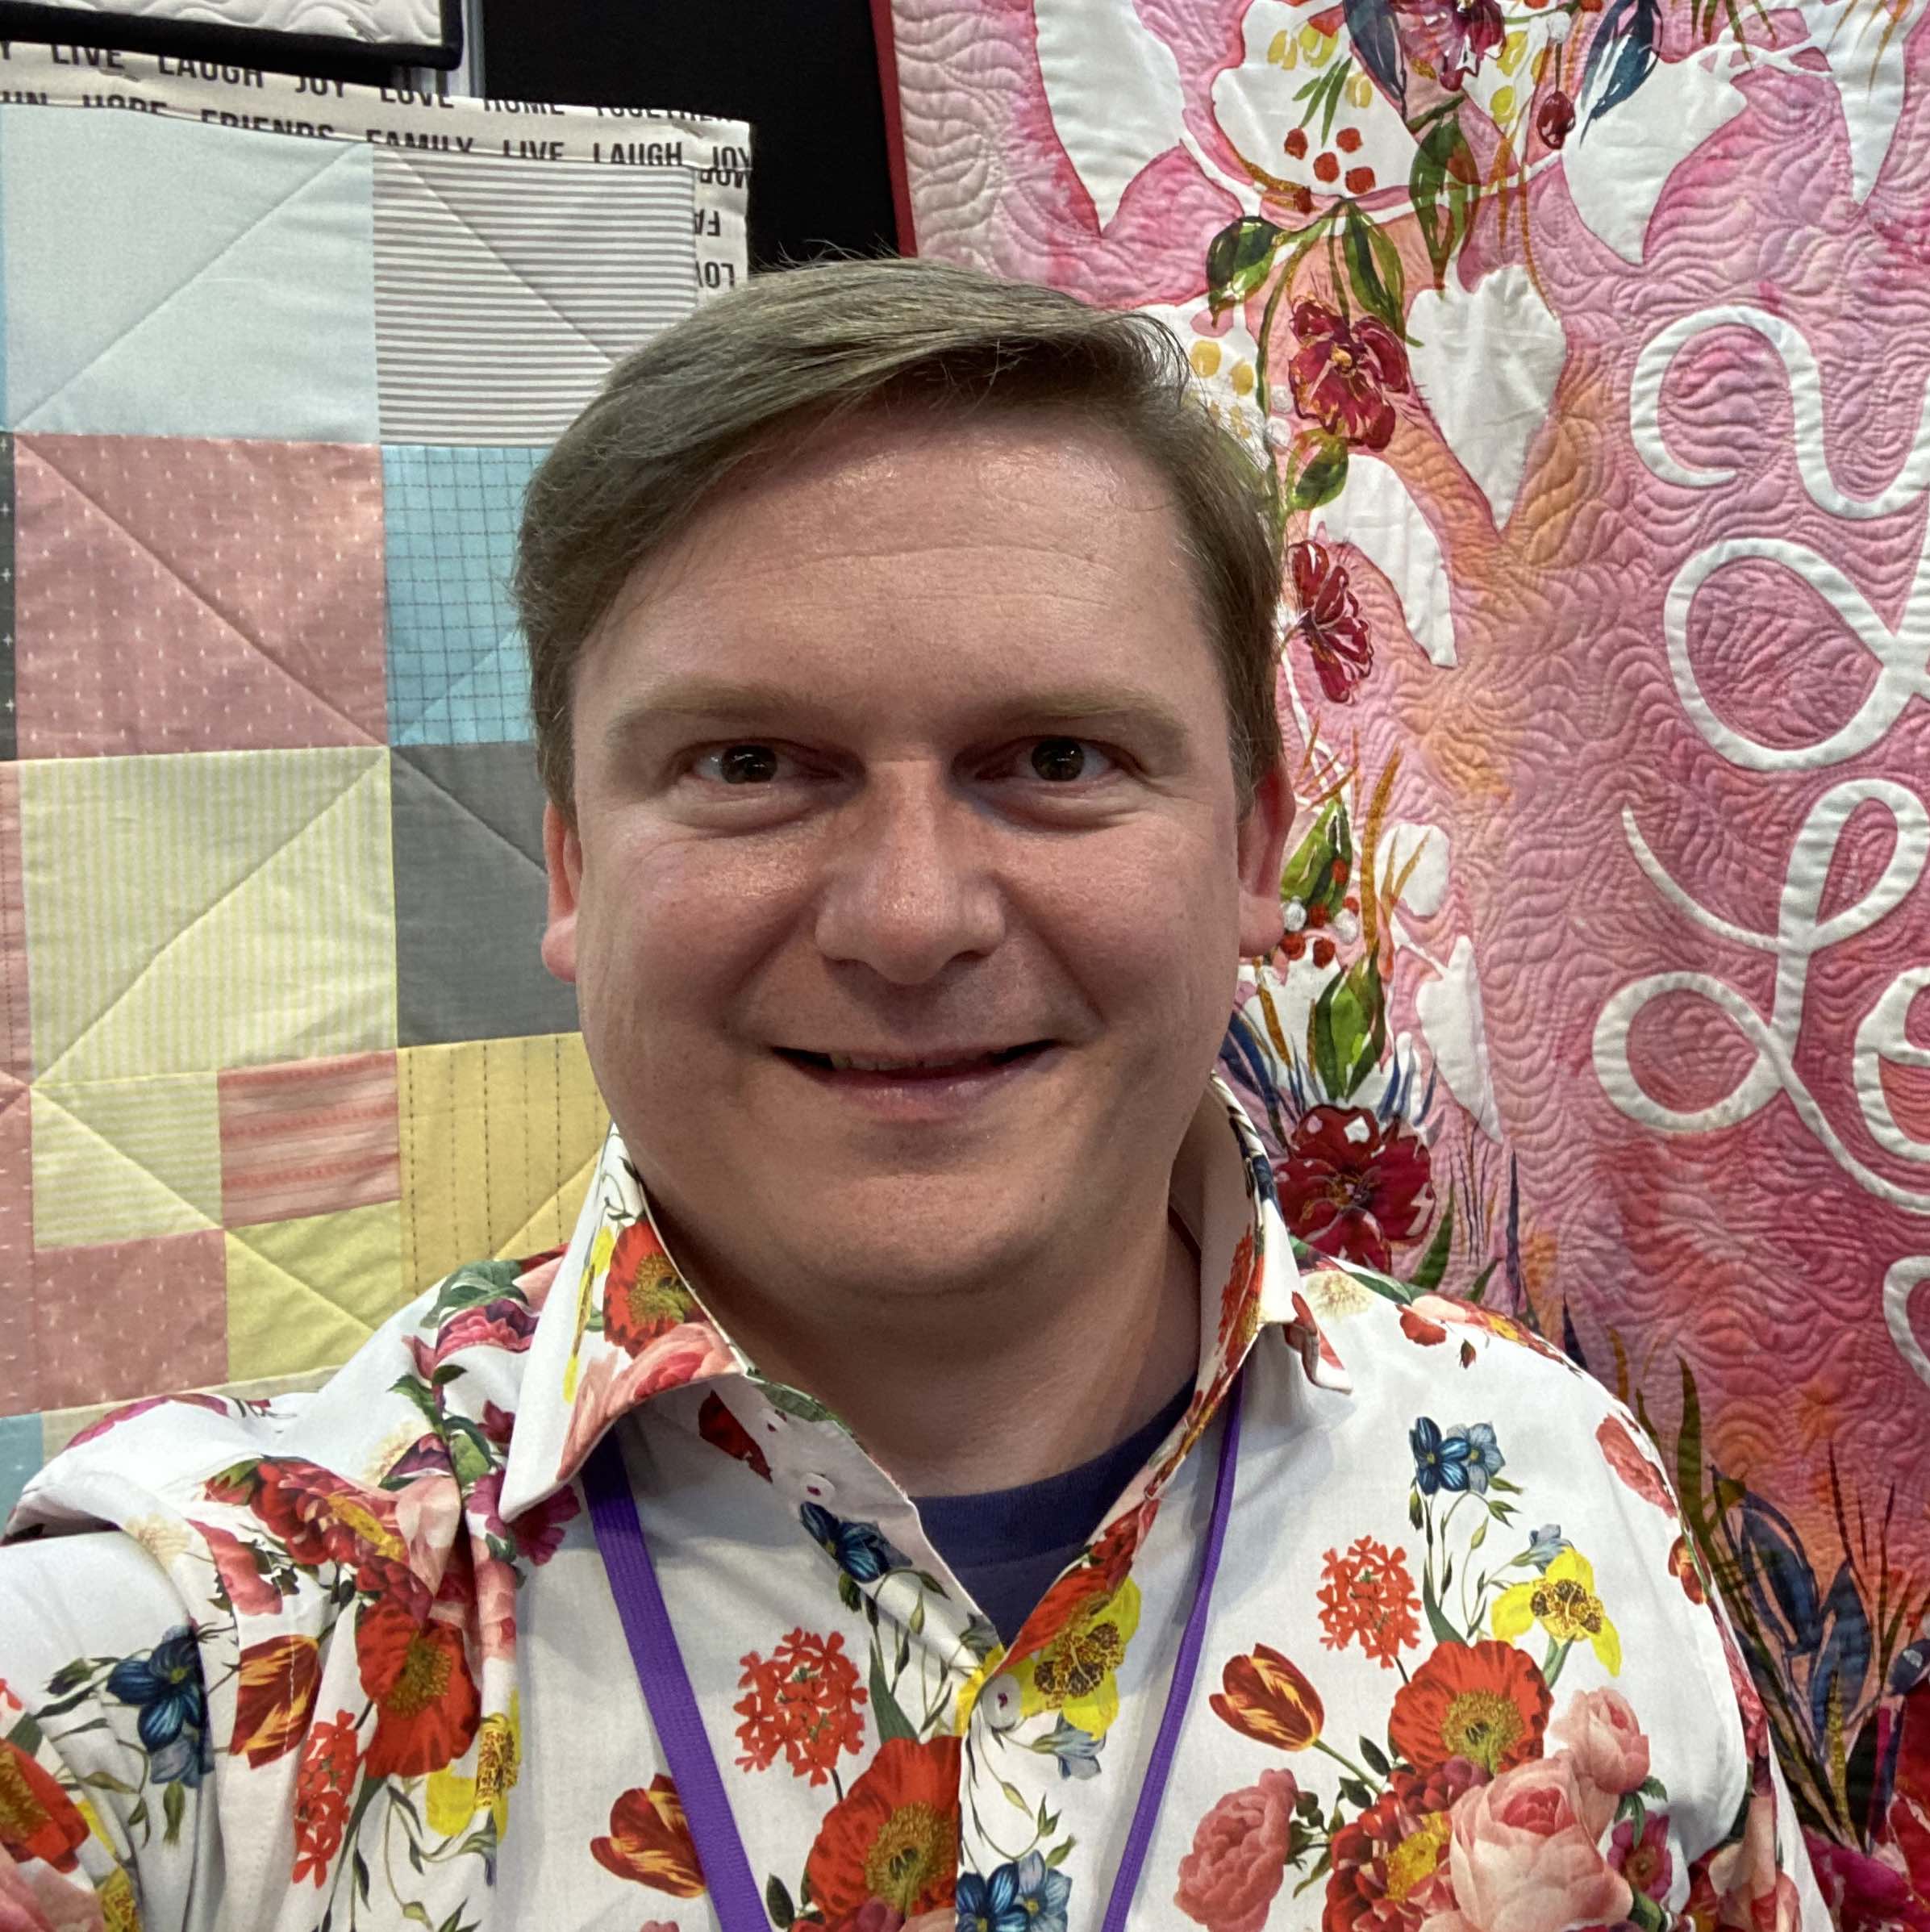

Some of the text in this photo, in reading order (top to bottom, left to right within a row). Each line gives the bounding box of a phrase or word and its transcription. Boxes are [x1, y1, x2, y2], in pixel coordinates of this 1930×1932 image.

[51, 44, 125, 69] LIVE
[158, 55, 263, 88] LAUGH
[593, 141, 682, 167] LAUGH
